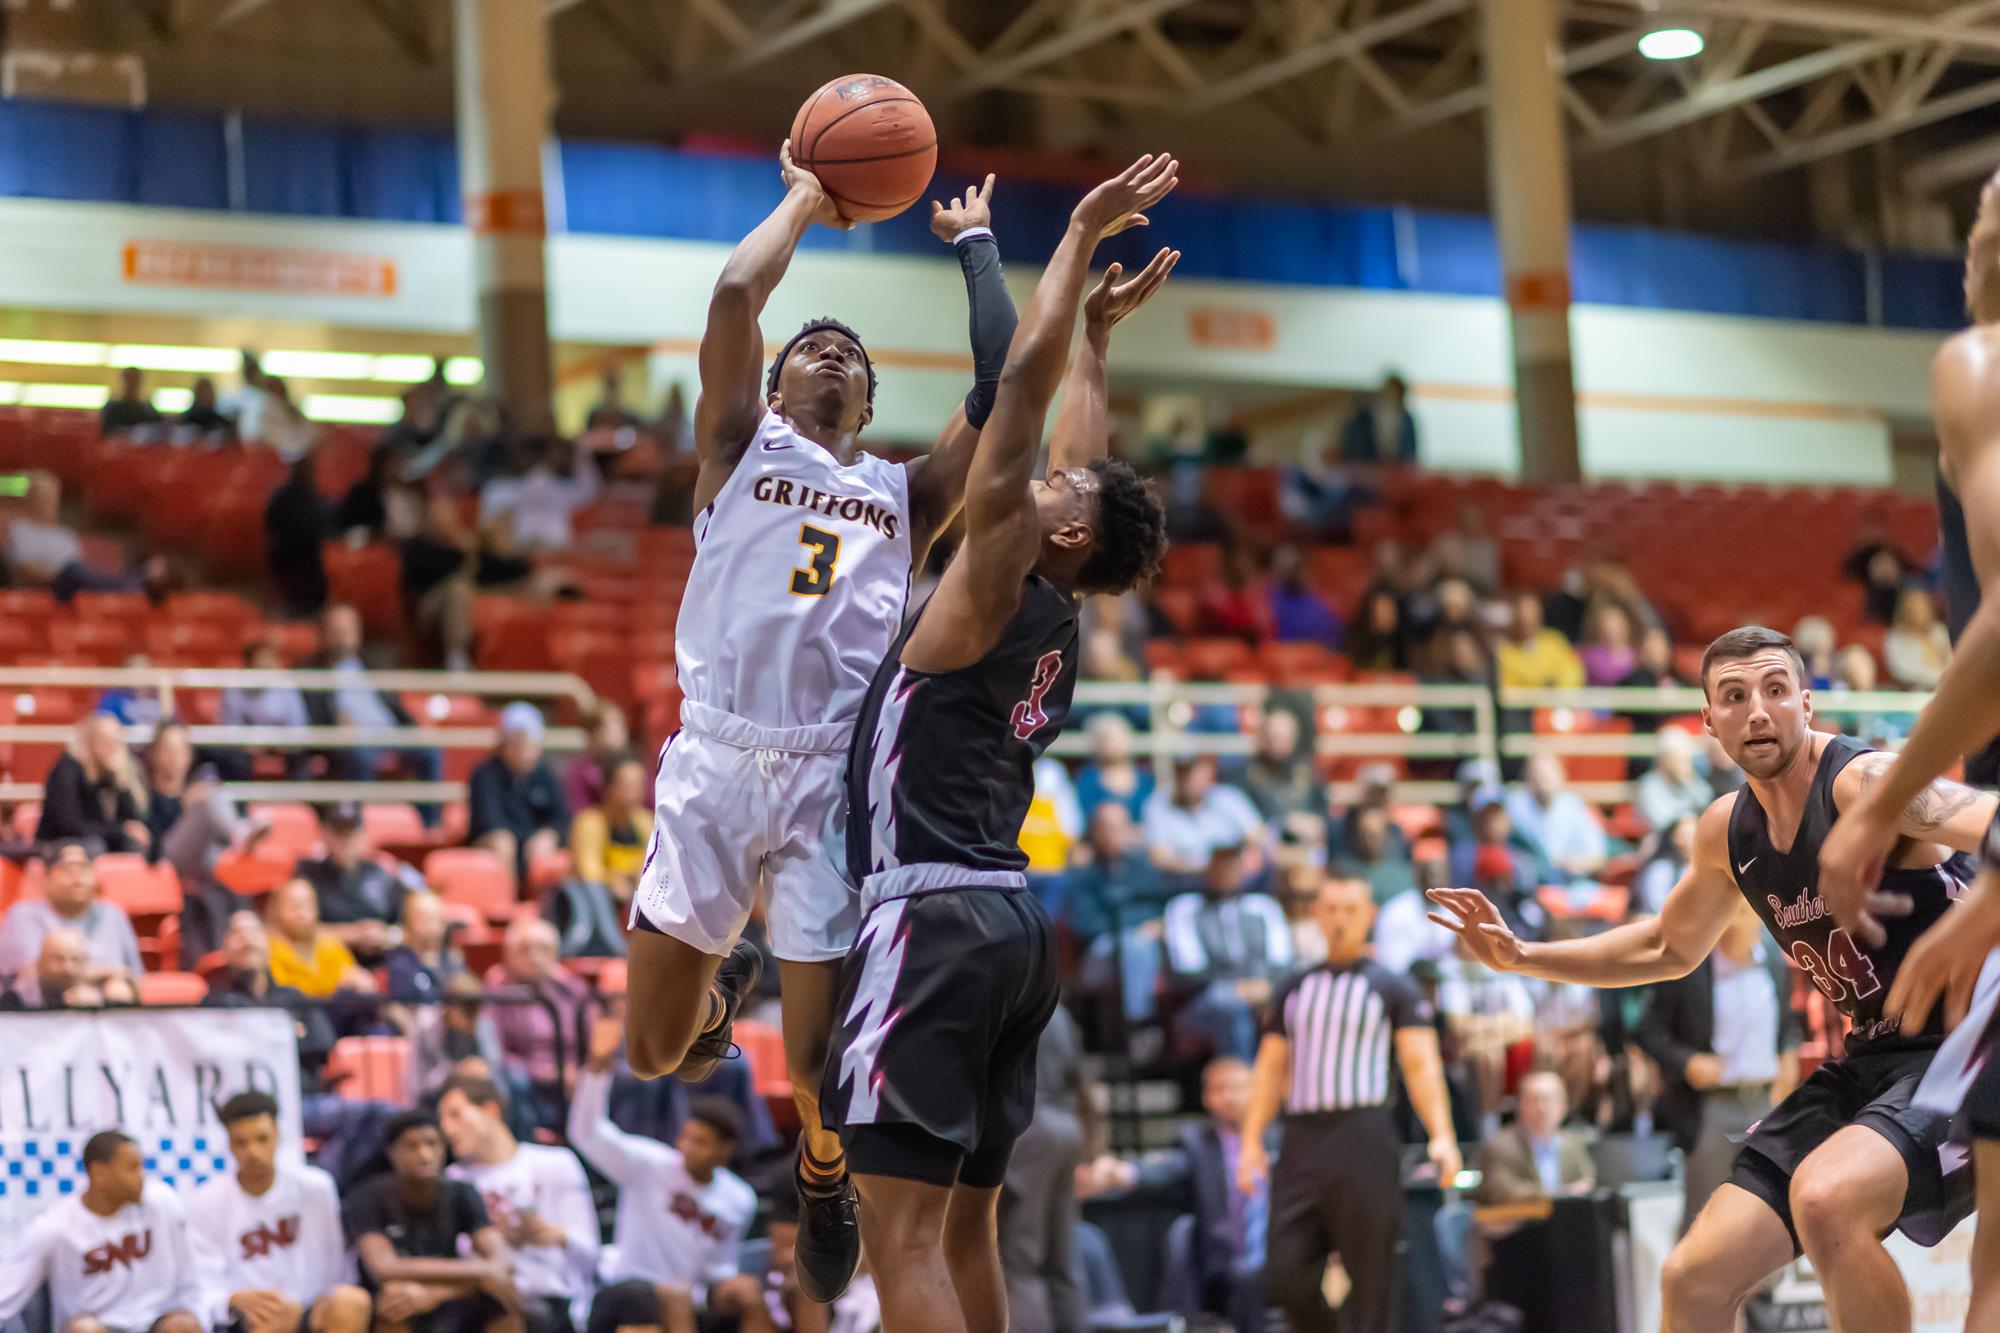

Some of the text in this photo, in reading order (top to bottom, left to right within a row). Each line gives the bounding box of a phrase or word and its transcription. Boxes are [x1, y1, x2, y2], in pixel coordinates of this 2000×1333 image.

[753, 476, 898, 540] GRIFFONS
[788, 522, 842, 598] 3
[1010, 649, 1063, 741] 3
[1767, 886, 1833, 930] Souther
[1791, 926, 1882, 1002] 34
[0, 1060, 279, 1132] LLYARD
[82, 1228, 152, 1276] SNU
[240, 1214, 302, 1261] SNU
